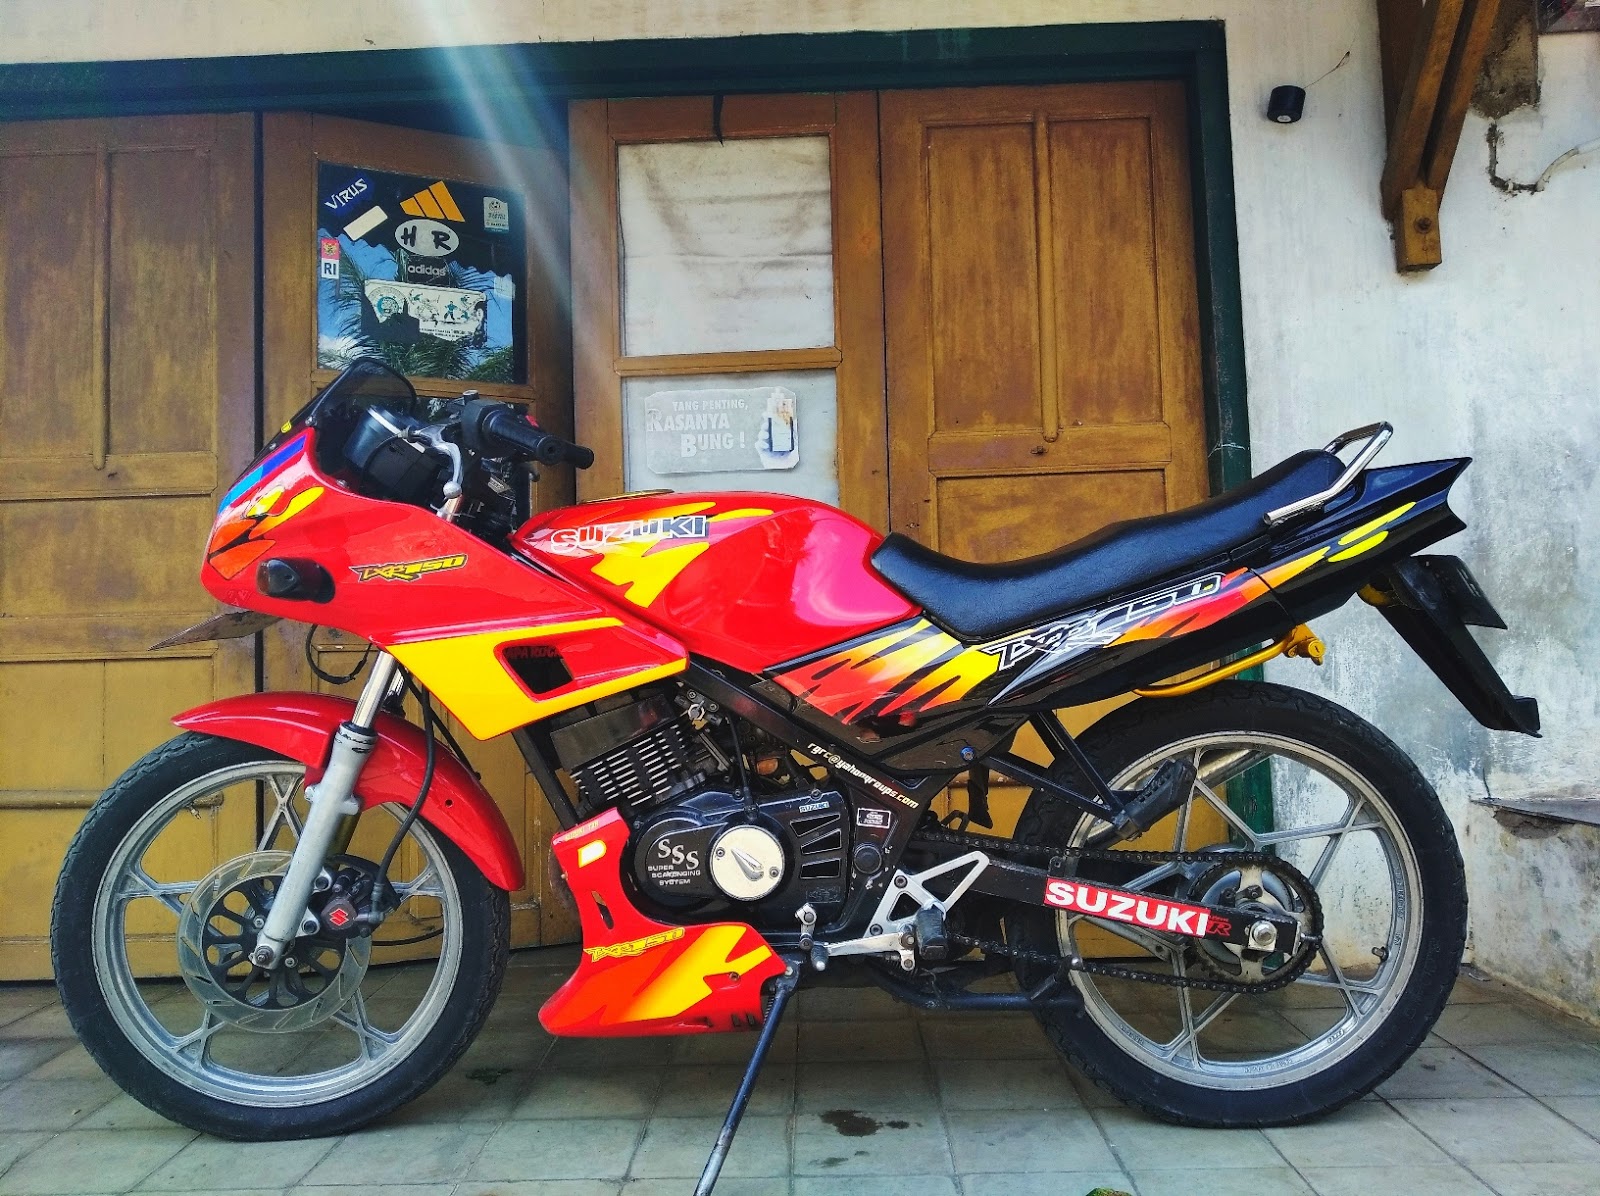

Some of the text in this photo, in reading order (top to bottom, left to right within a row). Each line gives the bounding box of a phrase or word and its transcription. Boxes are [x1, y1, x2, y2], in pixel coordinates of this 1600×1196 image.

[324, 178, 368, 209] VIRUS
[324, 262, 336, 275] RI
[407, 264, 447, 276] adidas
[672, 399, 749, 412] YANG PENTING,
[646, 408, 730, 432] RASANYA
[680, 432, 734, 458] BUNG
[551, 515, 710, 554] SUZUKI
[1046, 881, 1209, 937] SUZUKI
